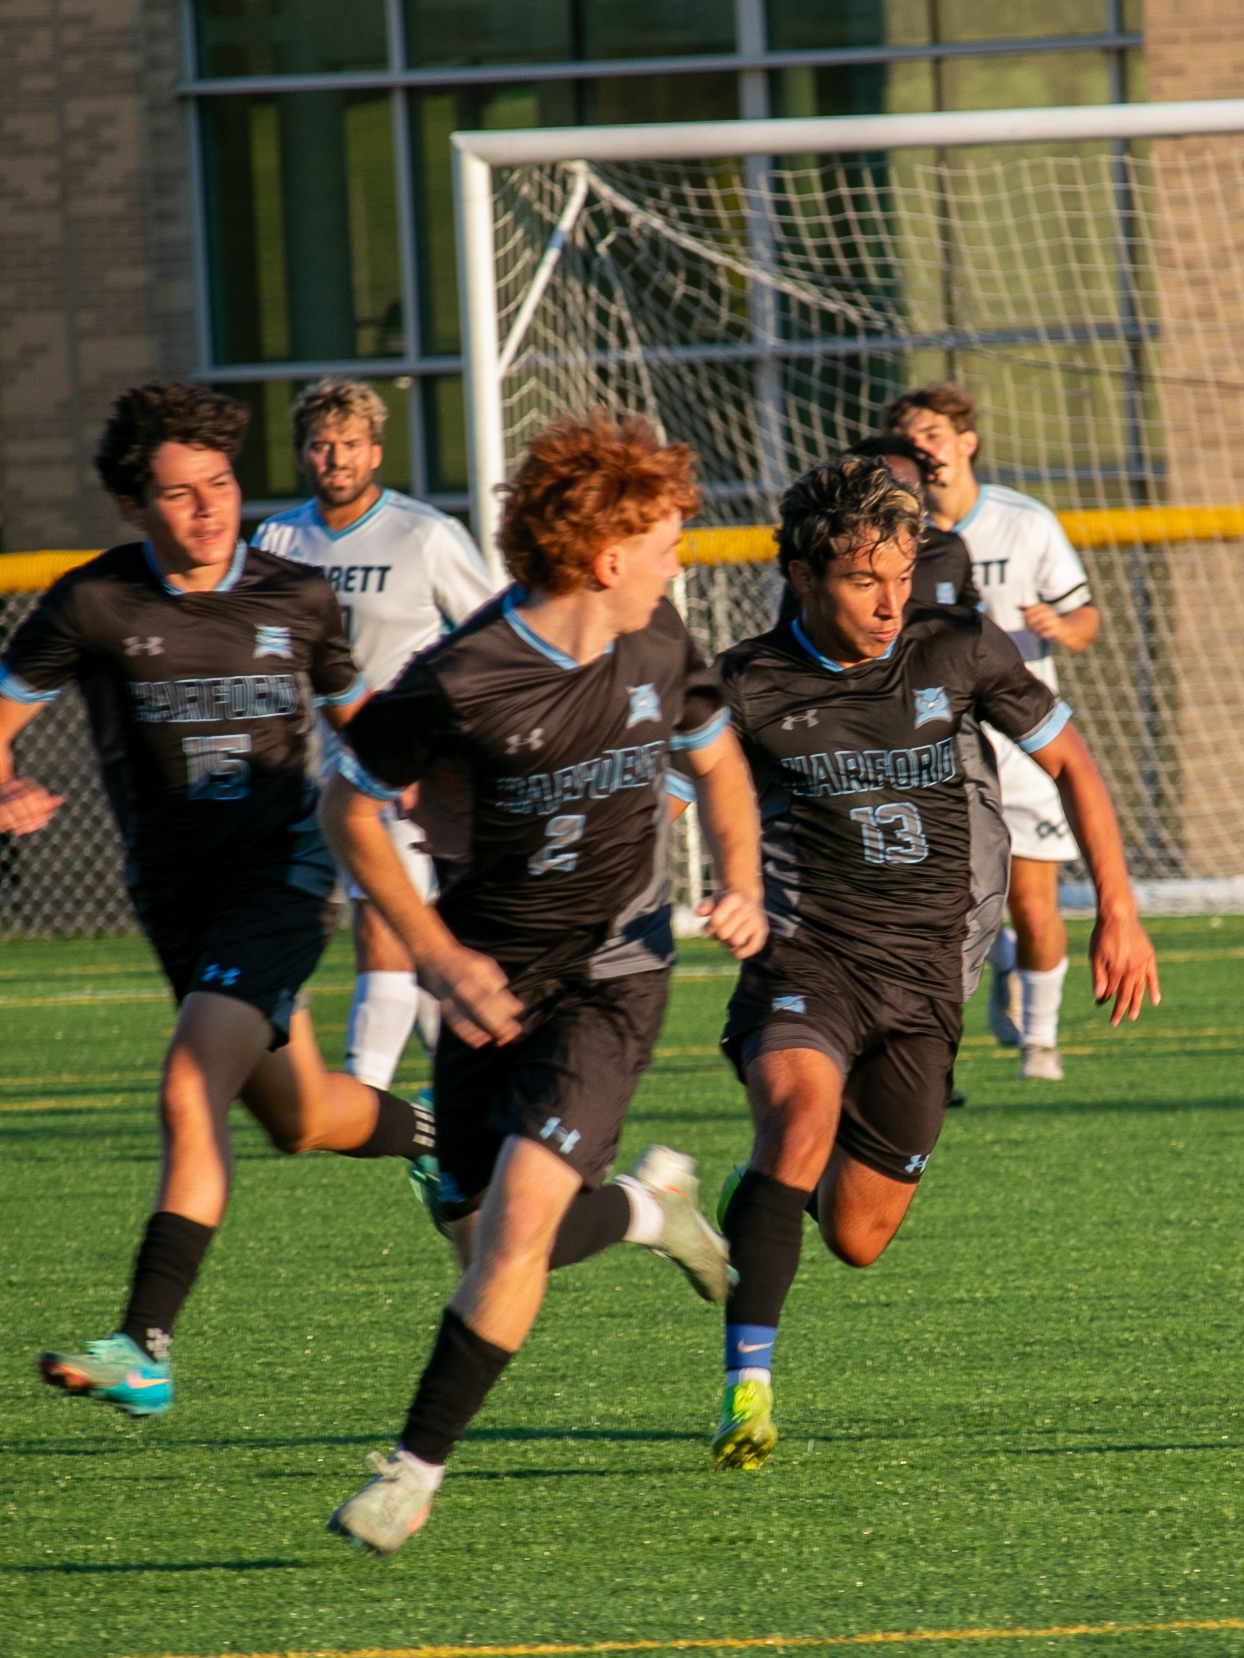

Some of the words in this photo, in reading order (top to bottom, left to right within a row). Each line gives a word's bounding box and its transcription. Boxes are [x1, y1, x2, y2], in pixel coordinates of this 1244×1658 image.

[182, 734, 251, 800] 15
[528, 814, 587, 875] 2
[850, 802, 929, 863] 13
